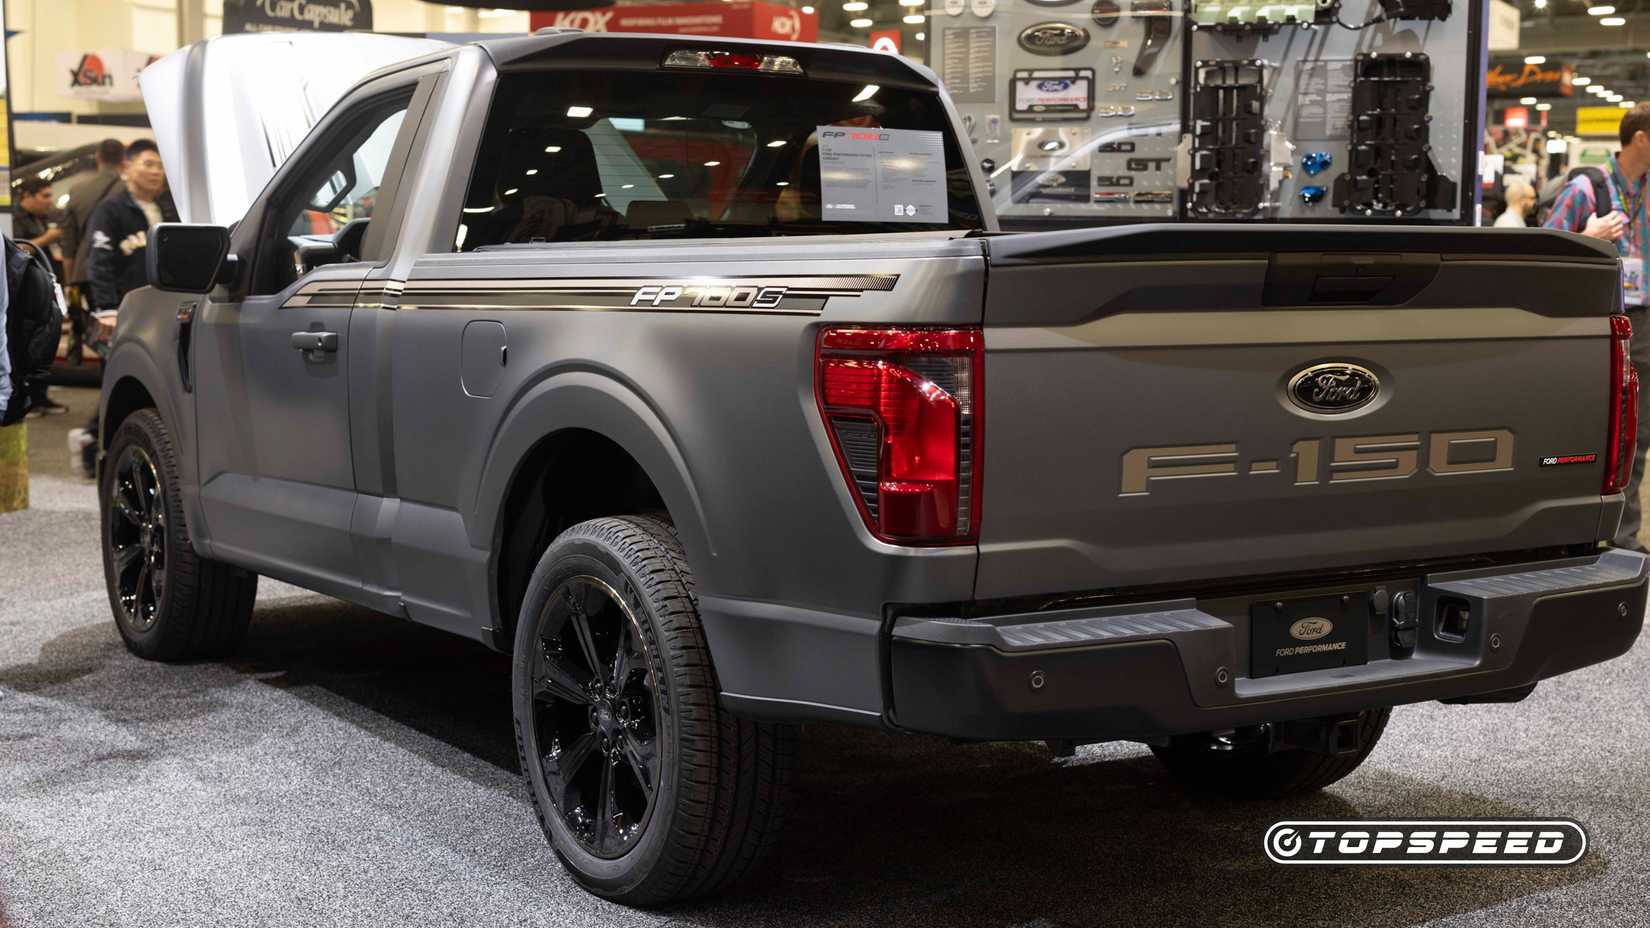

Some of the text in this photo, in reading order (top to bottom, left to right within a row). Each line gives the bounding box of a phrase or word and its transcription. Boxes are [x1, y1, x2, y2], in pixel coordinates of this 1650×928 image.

[1126, 157, 1172, 172] GT
[1117, 428, 1517, 498] F-150
[1543, 457, 1558, 465] FORD
[1276, 641, 1347, 657] FORD PERFORMANCE
